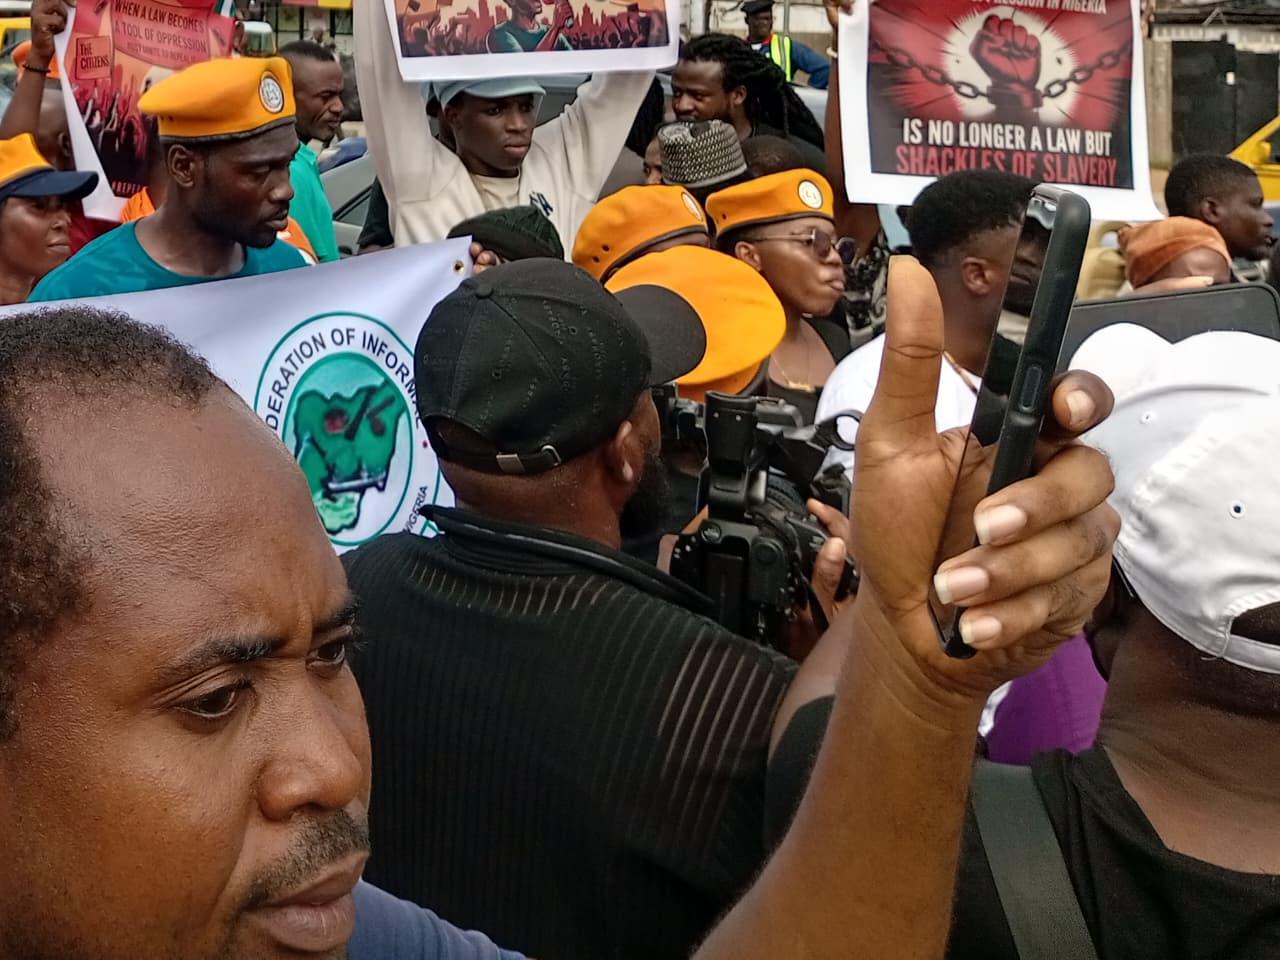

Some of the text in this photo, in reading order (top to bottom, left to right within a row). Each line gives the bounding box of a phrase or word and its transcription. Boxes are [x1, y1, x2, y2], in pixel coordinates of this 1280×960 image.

[114, 20, 208, 55] A TOOL OF OPPRESSION
[139, 6, 147, 19] A
[148, 7, 167, 25] LAW
[167, 10, 205, 34] BECOMES
[80, 43, 92, 55] THE
[80, 54, 110, 71] CITIZENS
[902, 117, 1112, 157] IS NO LONGER A LAW BUT
[896, 144, 1118, 187] SHACKLES OF SLAVERY
[265, 331, 327, 431] DERATION
[330, 328, 356, 346] OF
